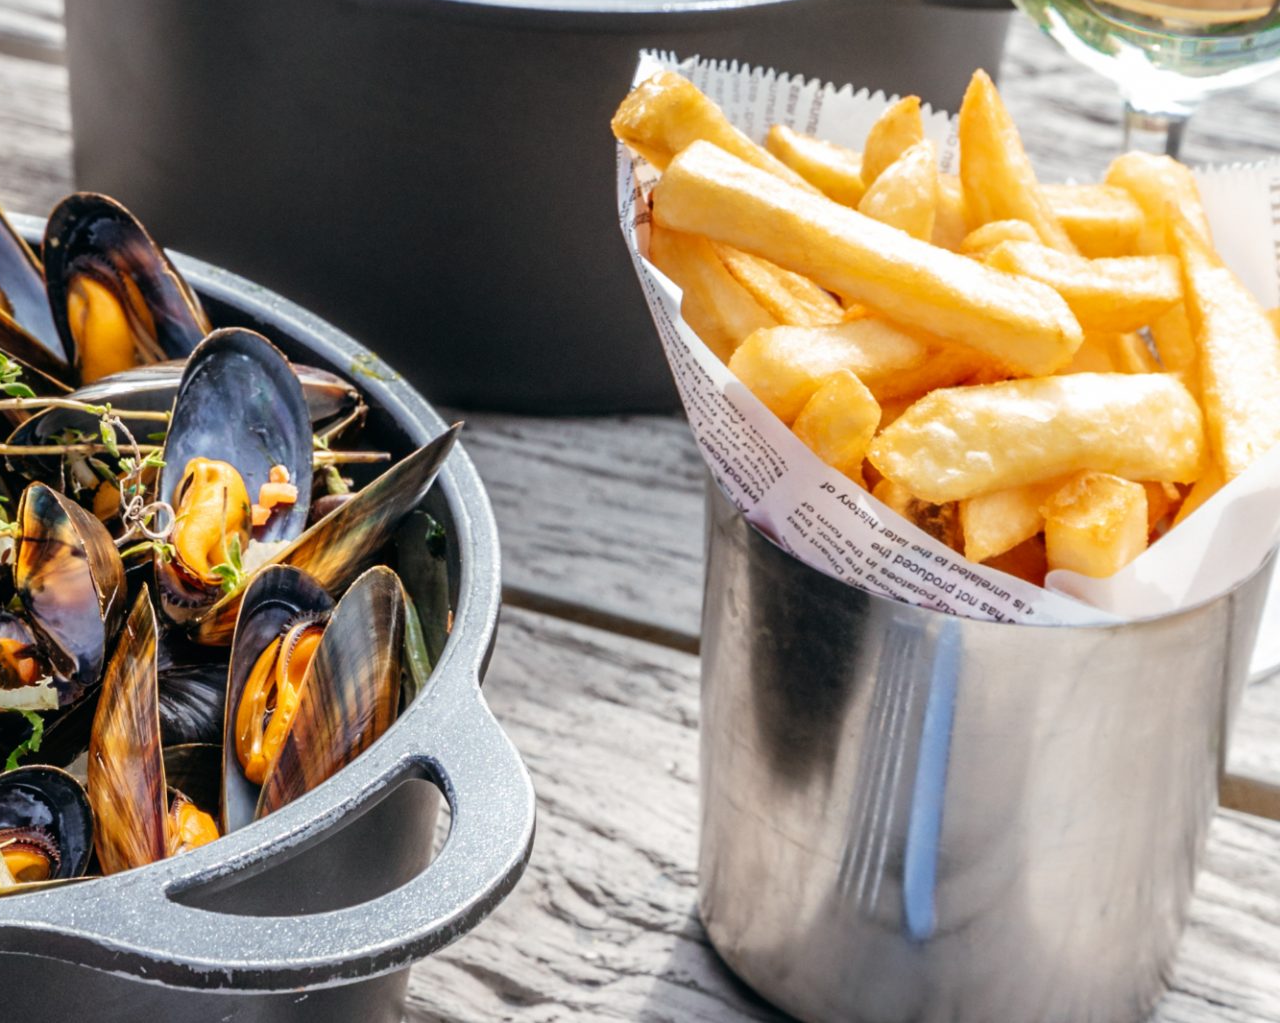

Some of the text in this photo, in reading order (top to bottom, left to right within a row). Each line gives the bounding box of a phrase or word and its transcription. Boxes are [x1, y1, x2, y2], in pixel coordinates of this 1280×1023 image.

[685, 362, 701, 385] the
[692, 358, 714, 386] was
[716, 428, 740, 451] and
[721, 420, 740, 439] the
[706, 430, 730, 456] War
[742, 442, 755, 453] of
[742, 428, 783, 478] Belgian
[699, 437, 760, 504] introduced
[732, 457, 764, 497] World
[819, 482, 836, 493] of
[794, 508, 813, 527] but
[801, 502, 815, 513] of
[836, 494, 878, 530] history
[816, 514, 842, 539] form
[878, 528, 909, 547] later
[845, 540, 863, 558] the
[911, 545, 933, 559] the
[845, 557, 863, 575] the
[865, 557, 878, 569] in
[934, 556, 948, 567] to
[871, 542, 1004, 623] has not produced the
[880, 567, 937, 601] potatoes
[948, 563, 1011, 601] unrelated
[1012, 599, 1025, 611] is
